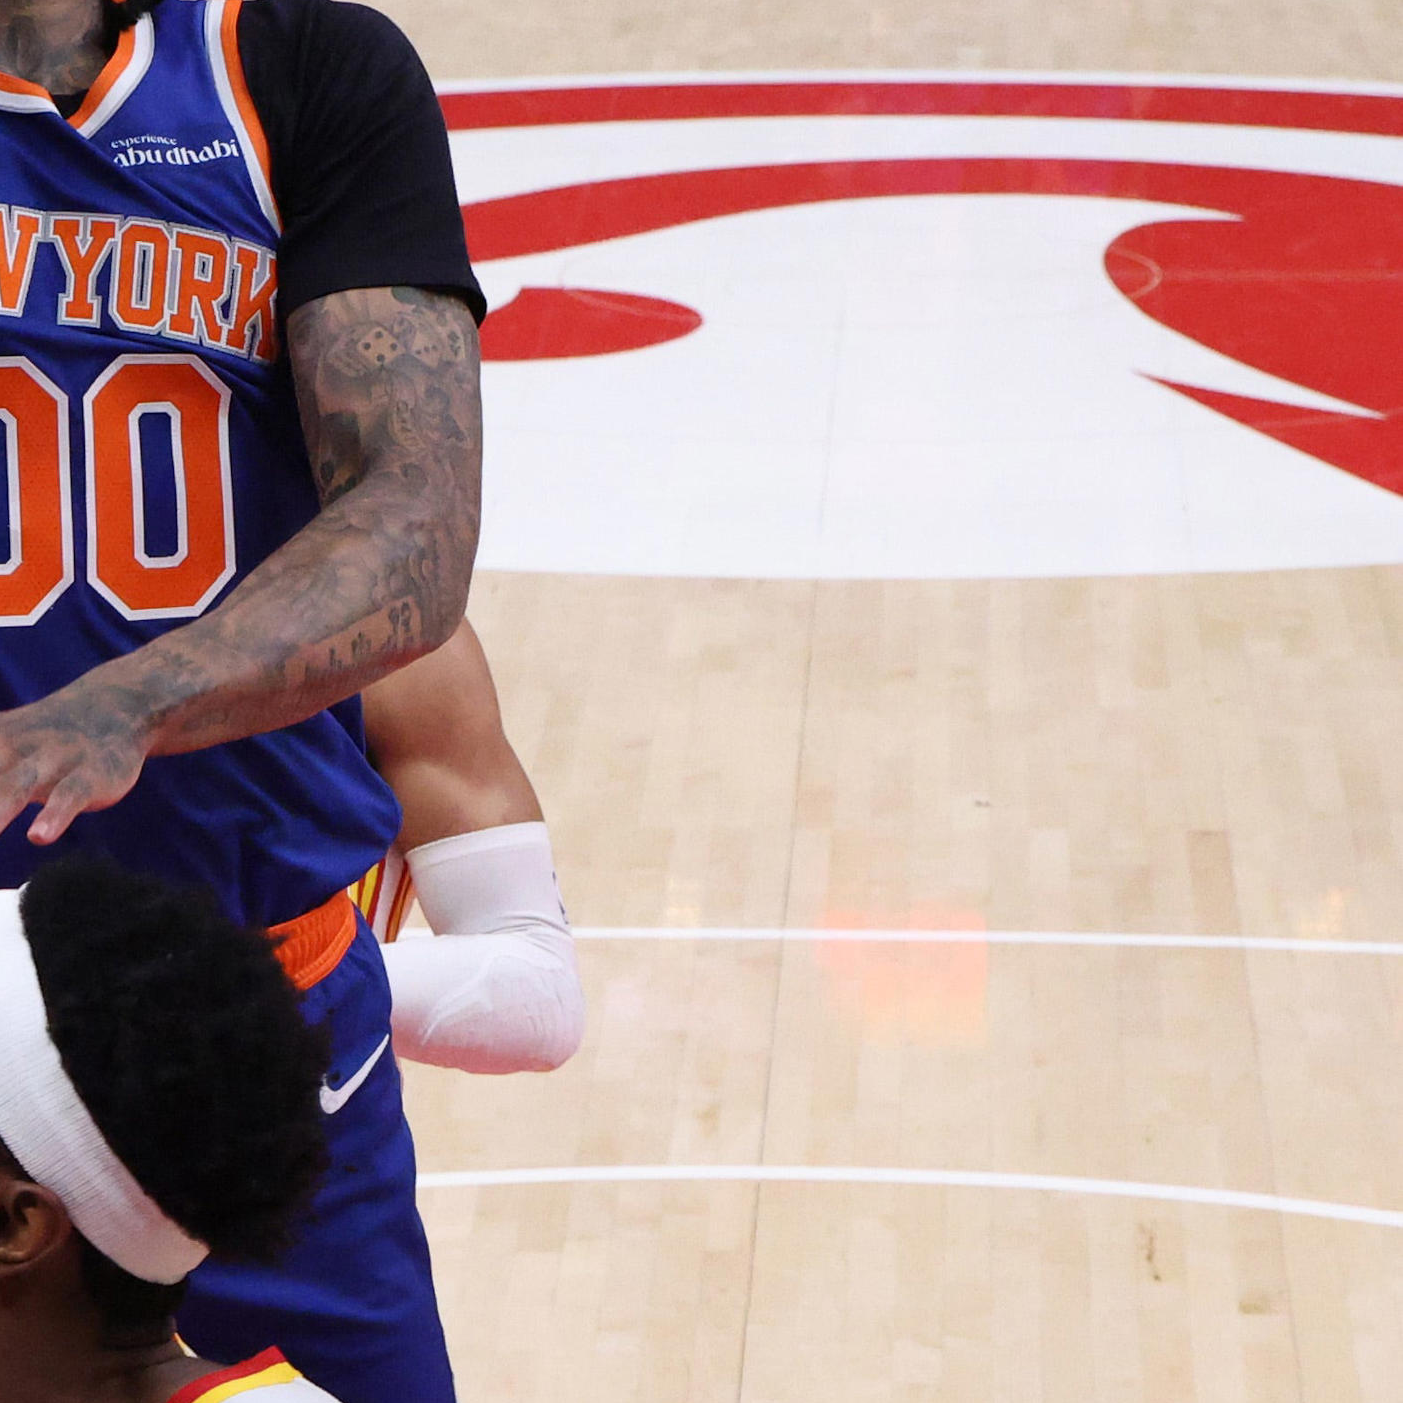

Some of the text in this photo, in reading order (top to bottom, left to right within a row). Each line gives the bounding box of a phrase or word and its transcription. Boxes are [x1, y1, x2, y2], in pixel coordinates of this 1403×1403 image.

[110, 133, 177, 149] experience
[112, 139, 240, 168] abu dhabi
[49, 212, 278, 363] YORK
